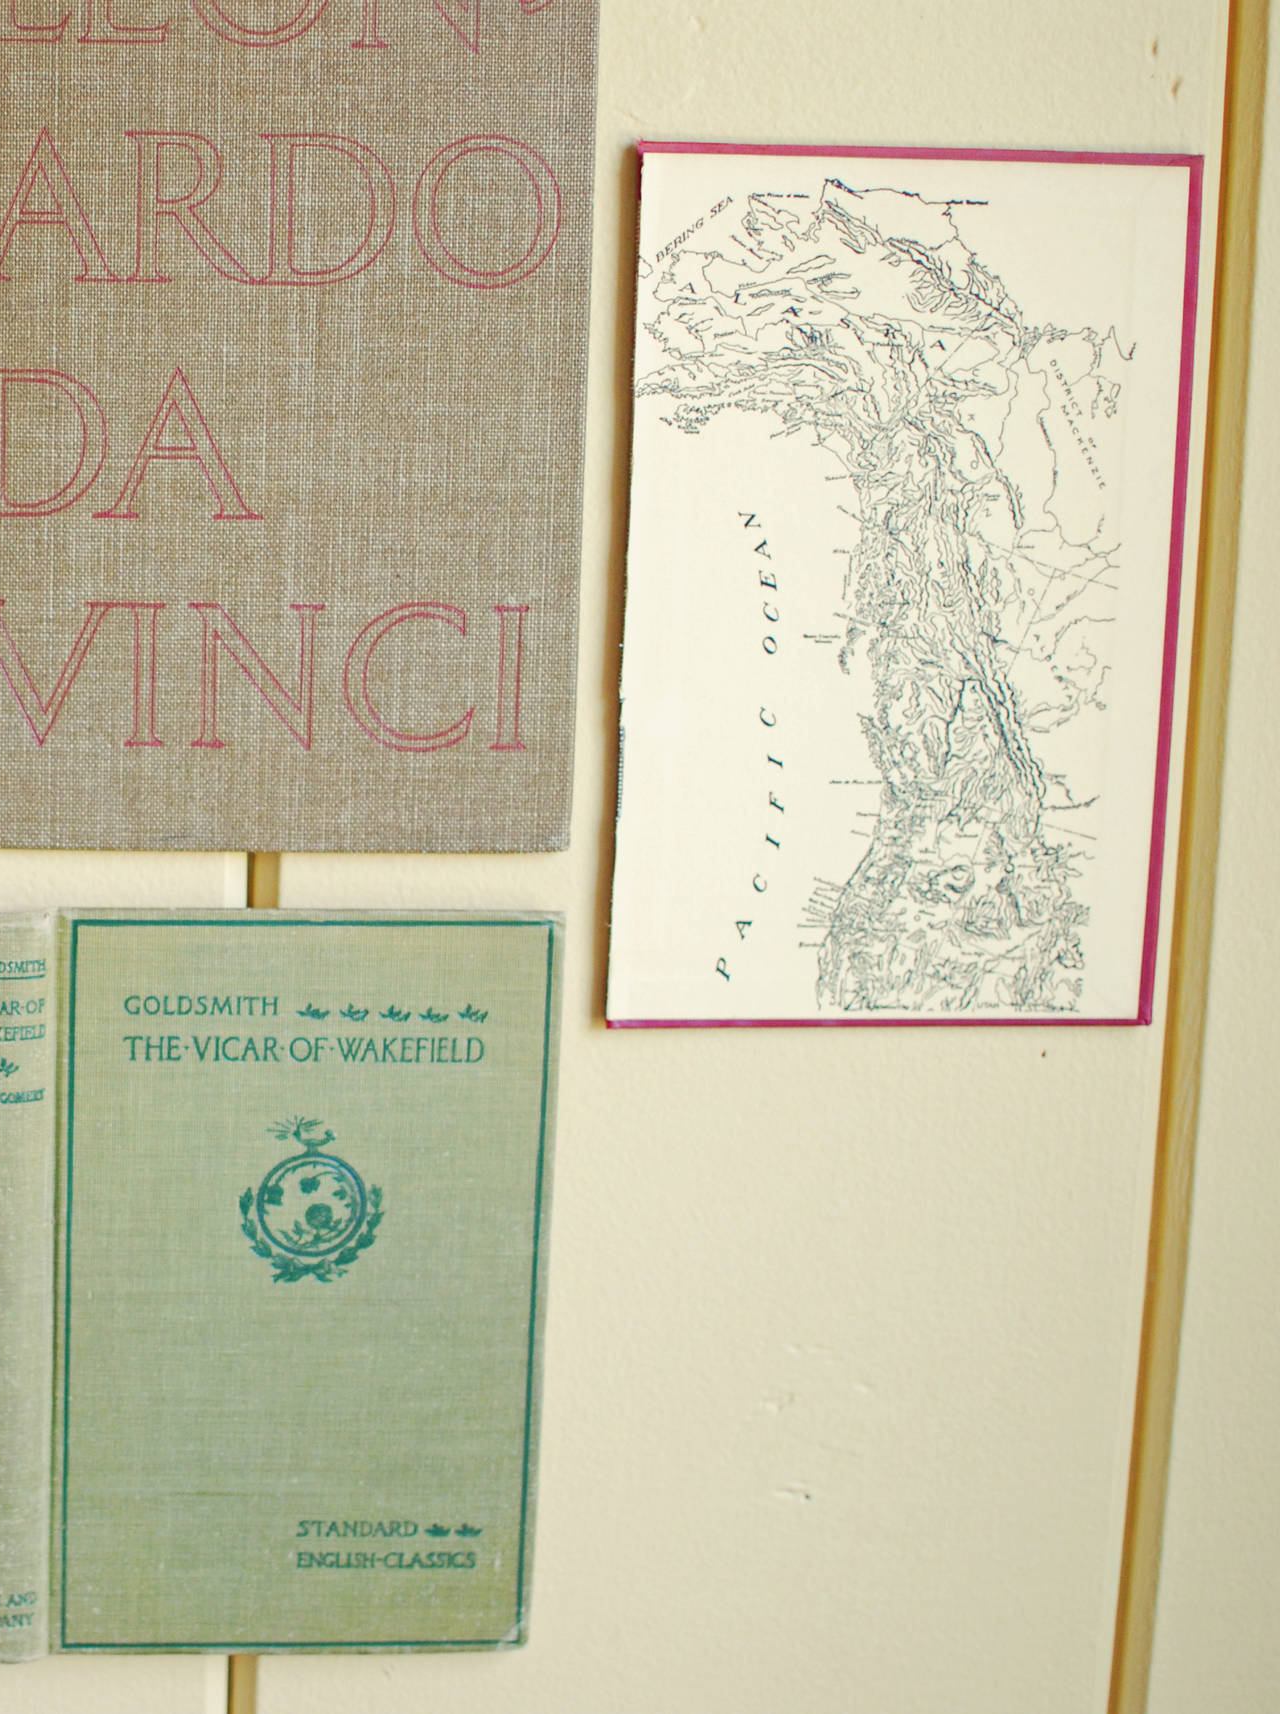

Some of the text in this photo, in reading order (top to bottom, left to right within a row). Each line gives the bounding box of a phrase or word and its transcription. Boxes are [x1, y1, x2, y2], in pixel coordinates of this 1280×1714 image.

[656, 217, 705, 263] BERING
[709, 196, 733, 218] SEA
[715, 511, 784, 982] PACIFIC OCEAN
[123, 995, 279, 1016] GOLDSMITH
[296, 1520, 419, 1538] STANDARD
